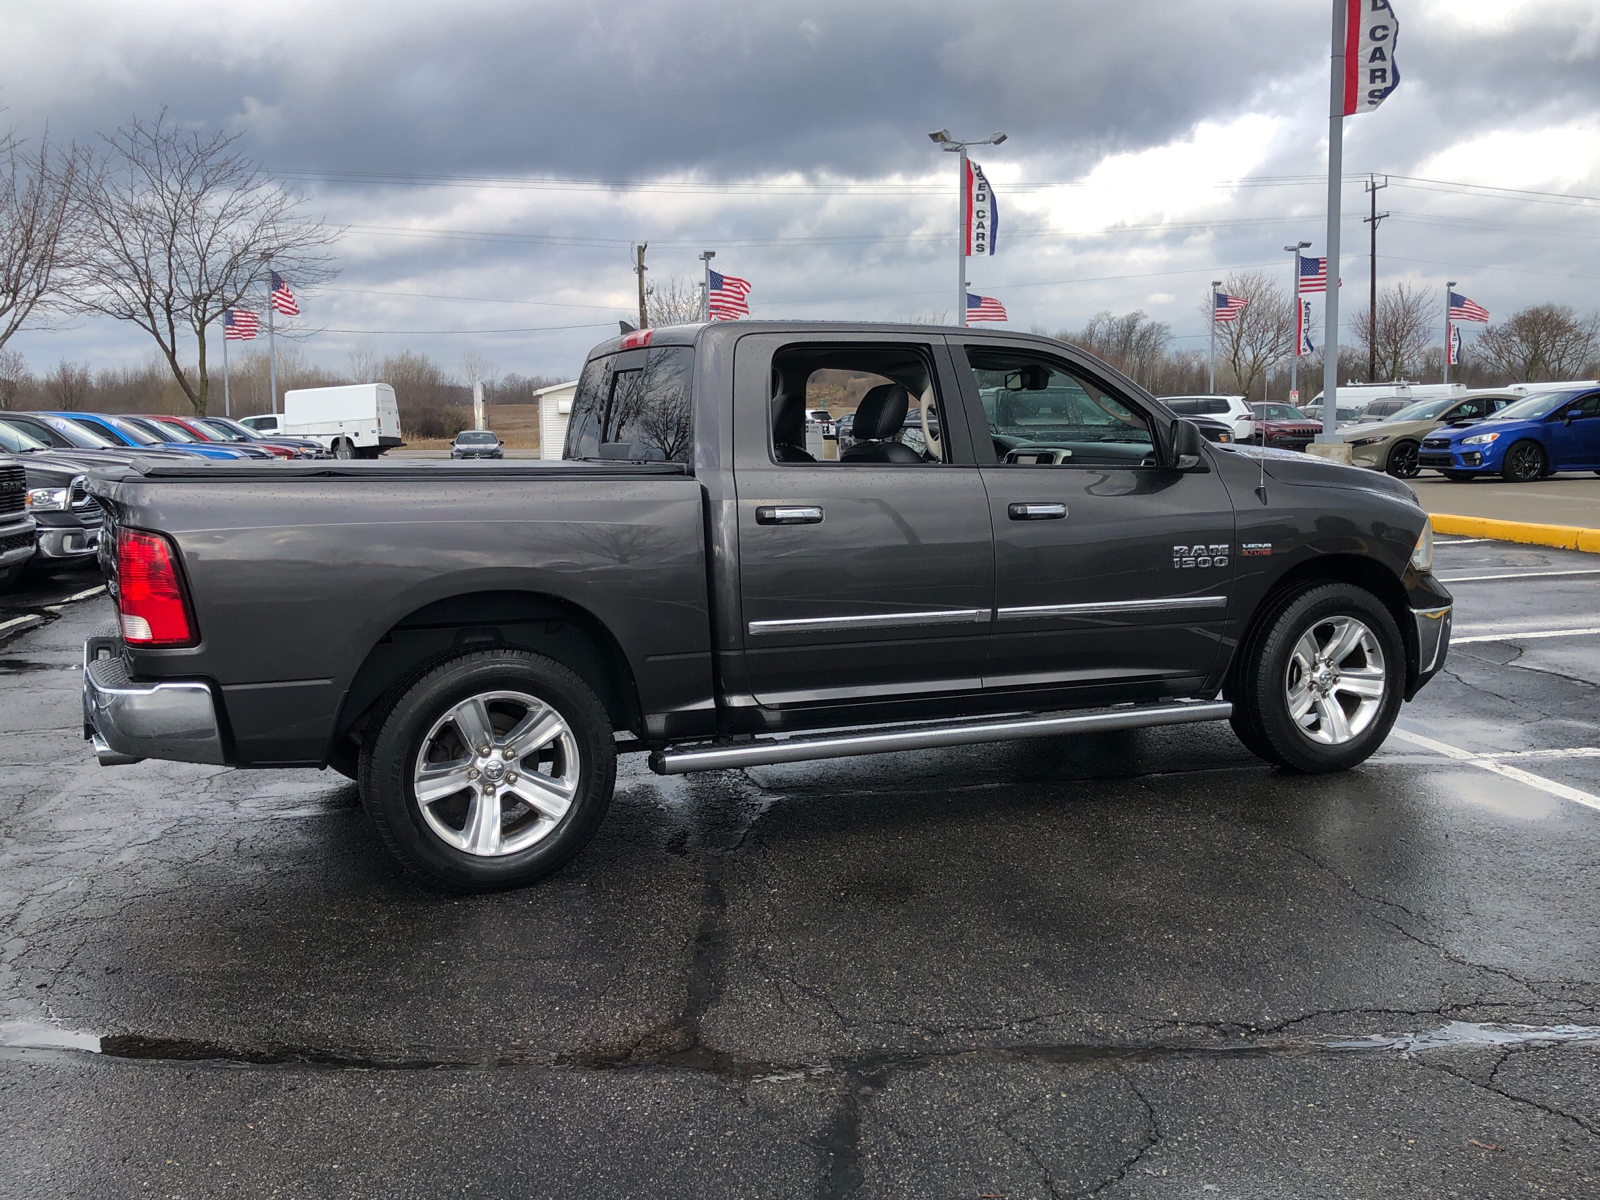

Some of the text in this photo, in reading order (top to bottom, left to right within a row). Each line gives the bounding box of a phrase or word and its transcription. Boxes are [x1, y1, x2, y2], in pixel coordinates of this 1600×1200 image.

[1367, 24, 1390, 105] CARS
[975, 209, 986, 253] CARS
[1173, 544, 1230, 557] RAM
[1173, 556, 1229, 569] 1500
